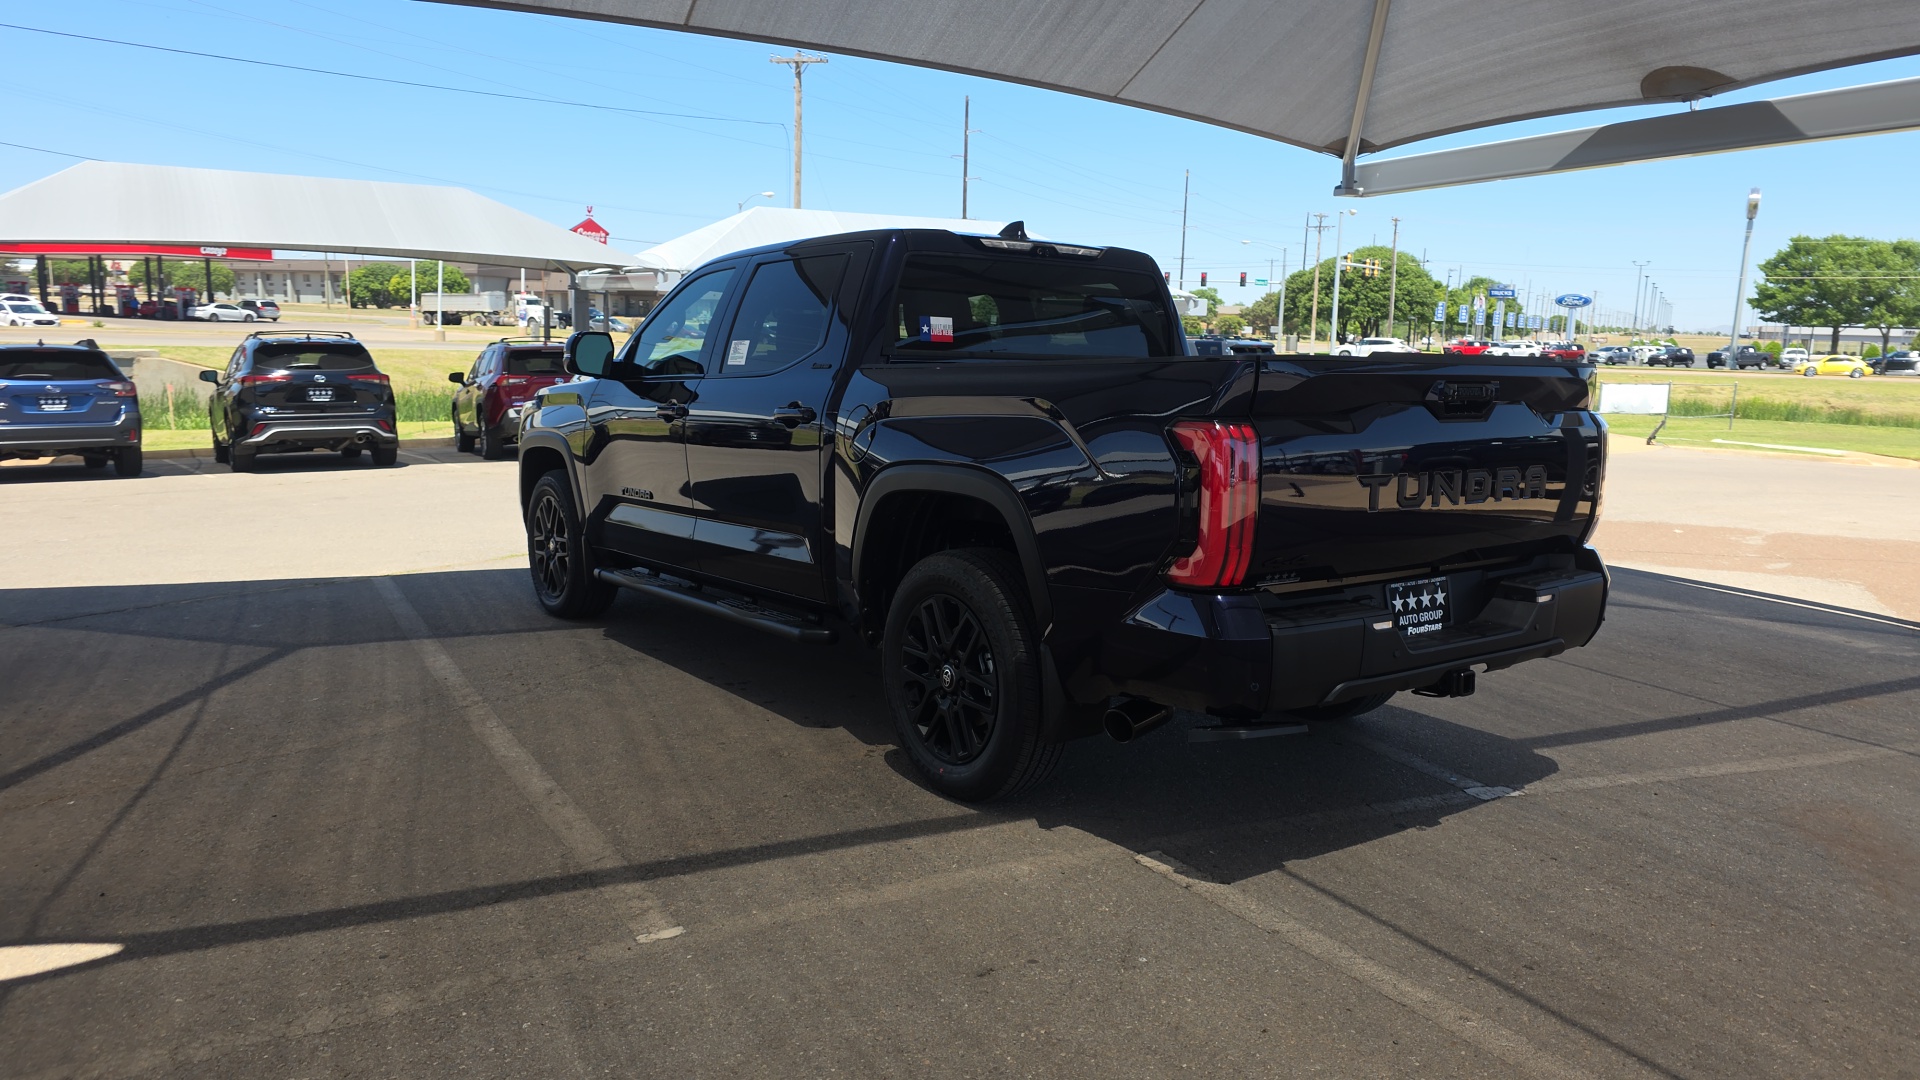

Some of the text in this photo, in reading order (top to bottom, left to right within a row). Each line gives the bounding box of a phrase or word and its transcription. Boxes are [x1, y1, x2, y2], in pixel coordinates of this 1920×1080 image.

[620, 486, 654, 500] TUNDRA
[1356, 464, 1548, 513] TUNDRA
[1399, 609, 1443, 626] AUTO GROUP
